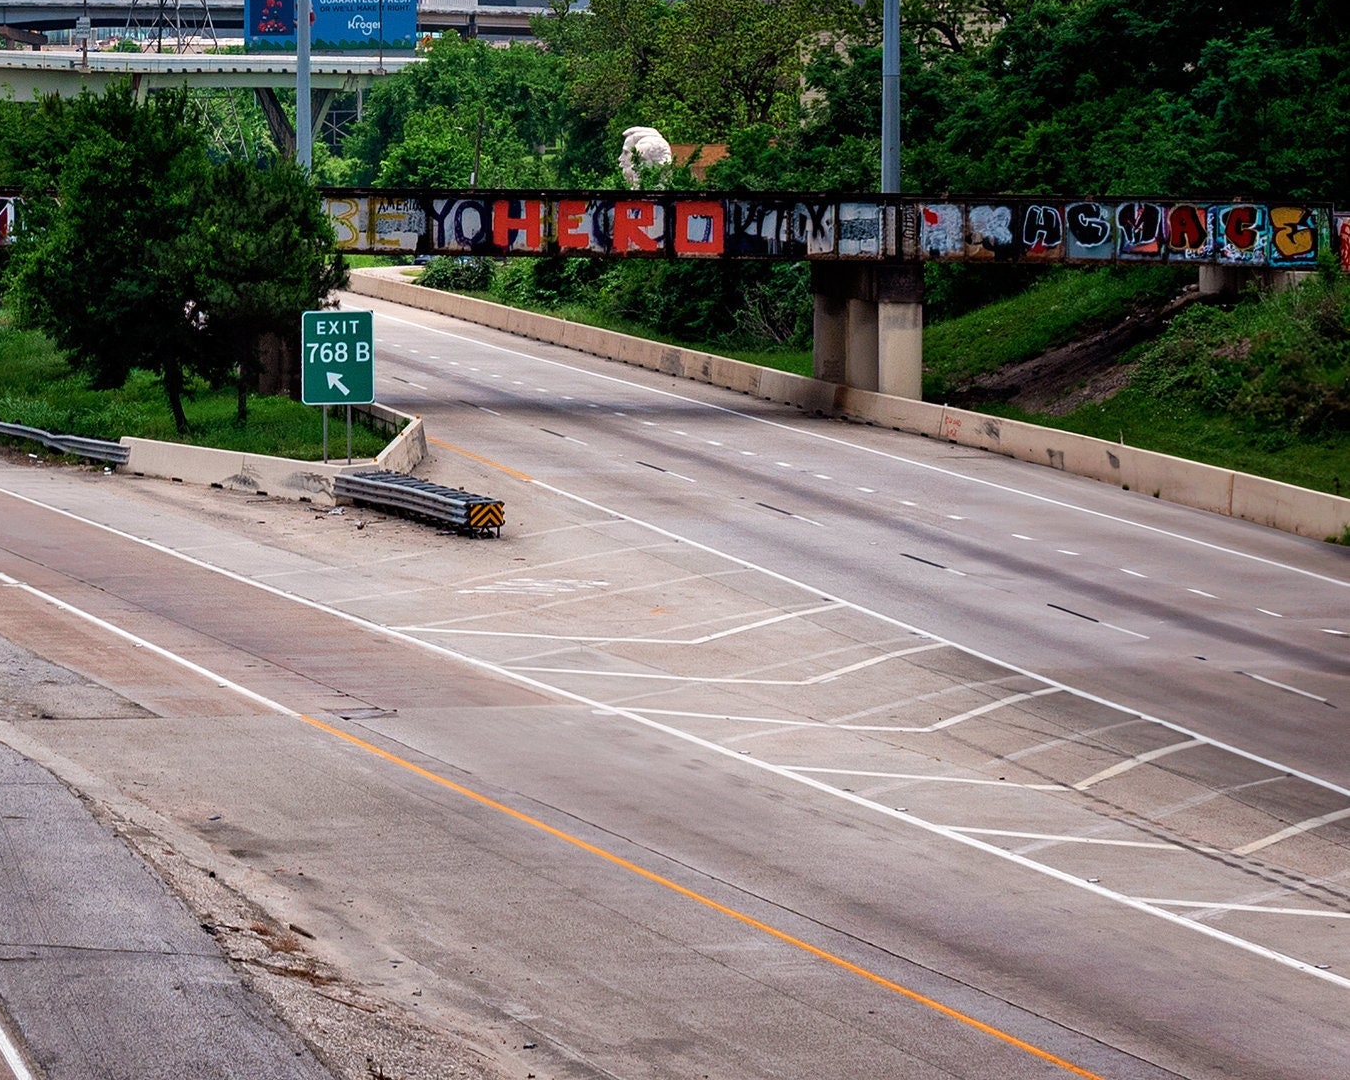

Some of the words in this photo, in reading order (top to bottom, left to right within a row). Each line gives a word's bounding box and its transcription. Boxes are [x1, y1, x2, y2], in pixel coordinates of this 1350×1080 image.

[493, 200, 725, 254] HERO
[316, 320, 359, 335] EXIT
[306, 342, 348, 363] 768
[356, 342, 370, 362] B
